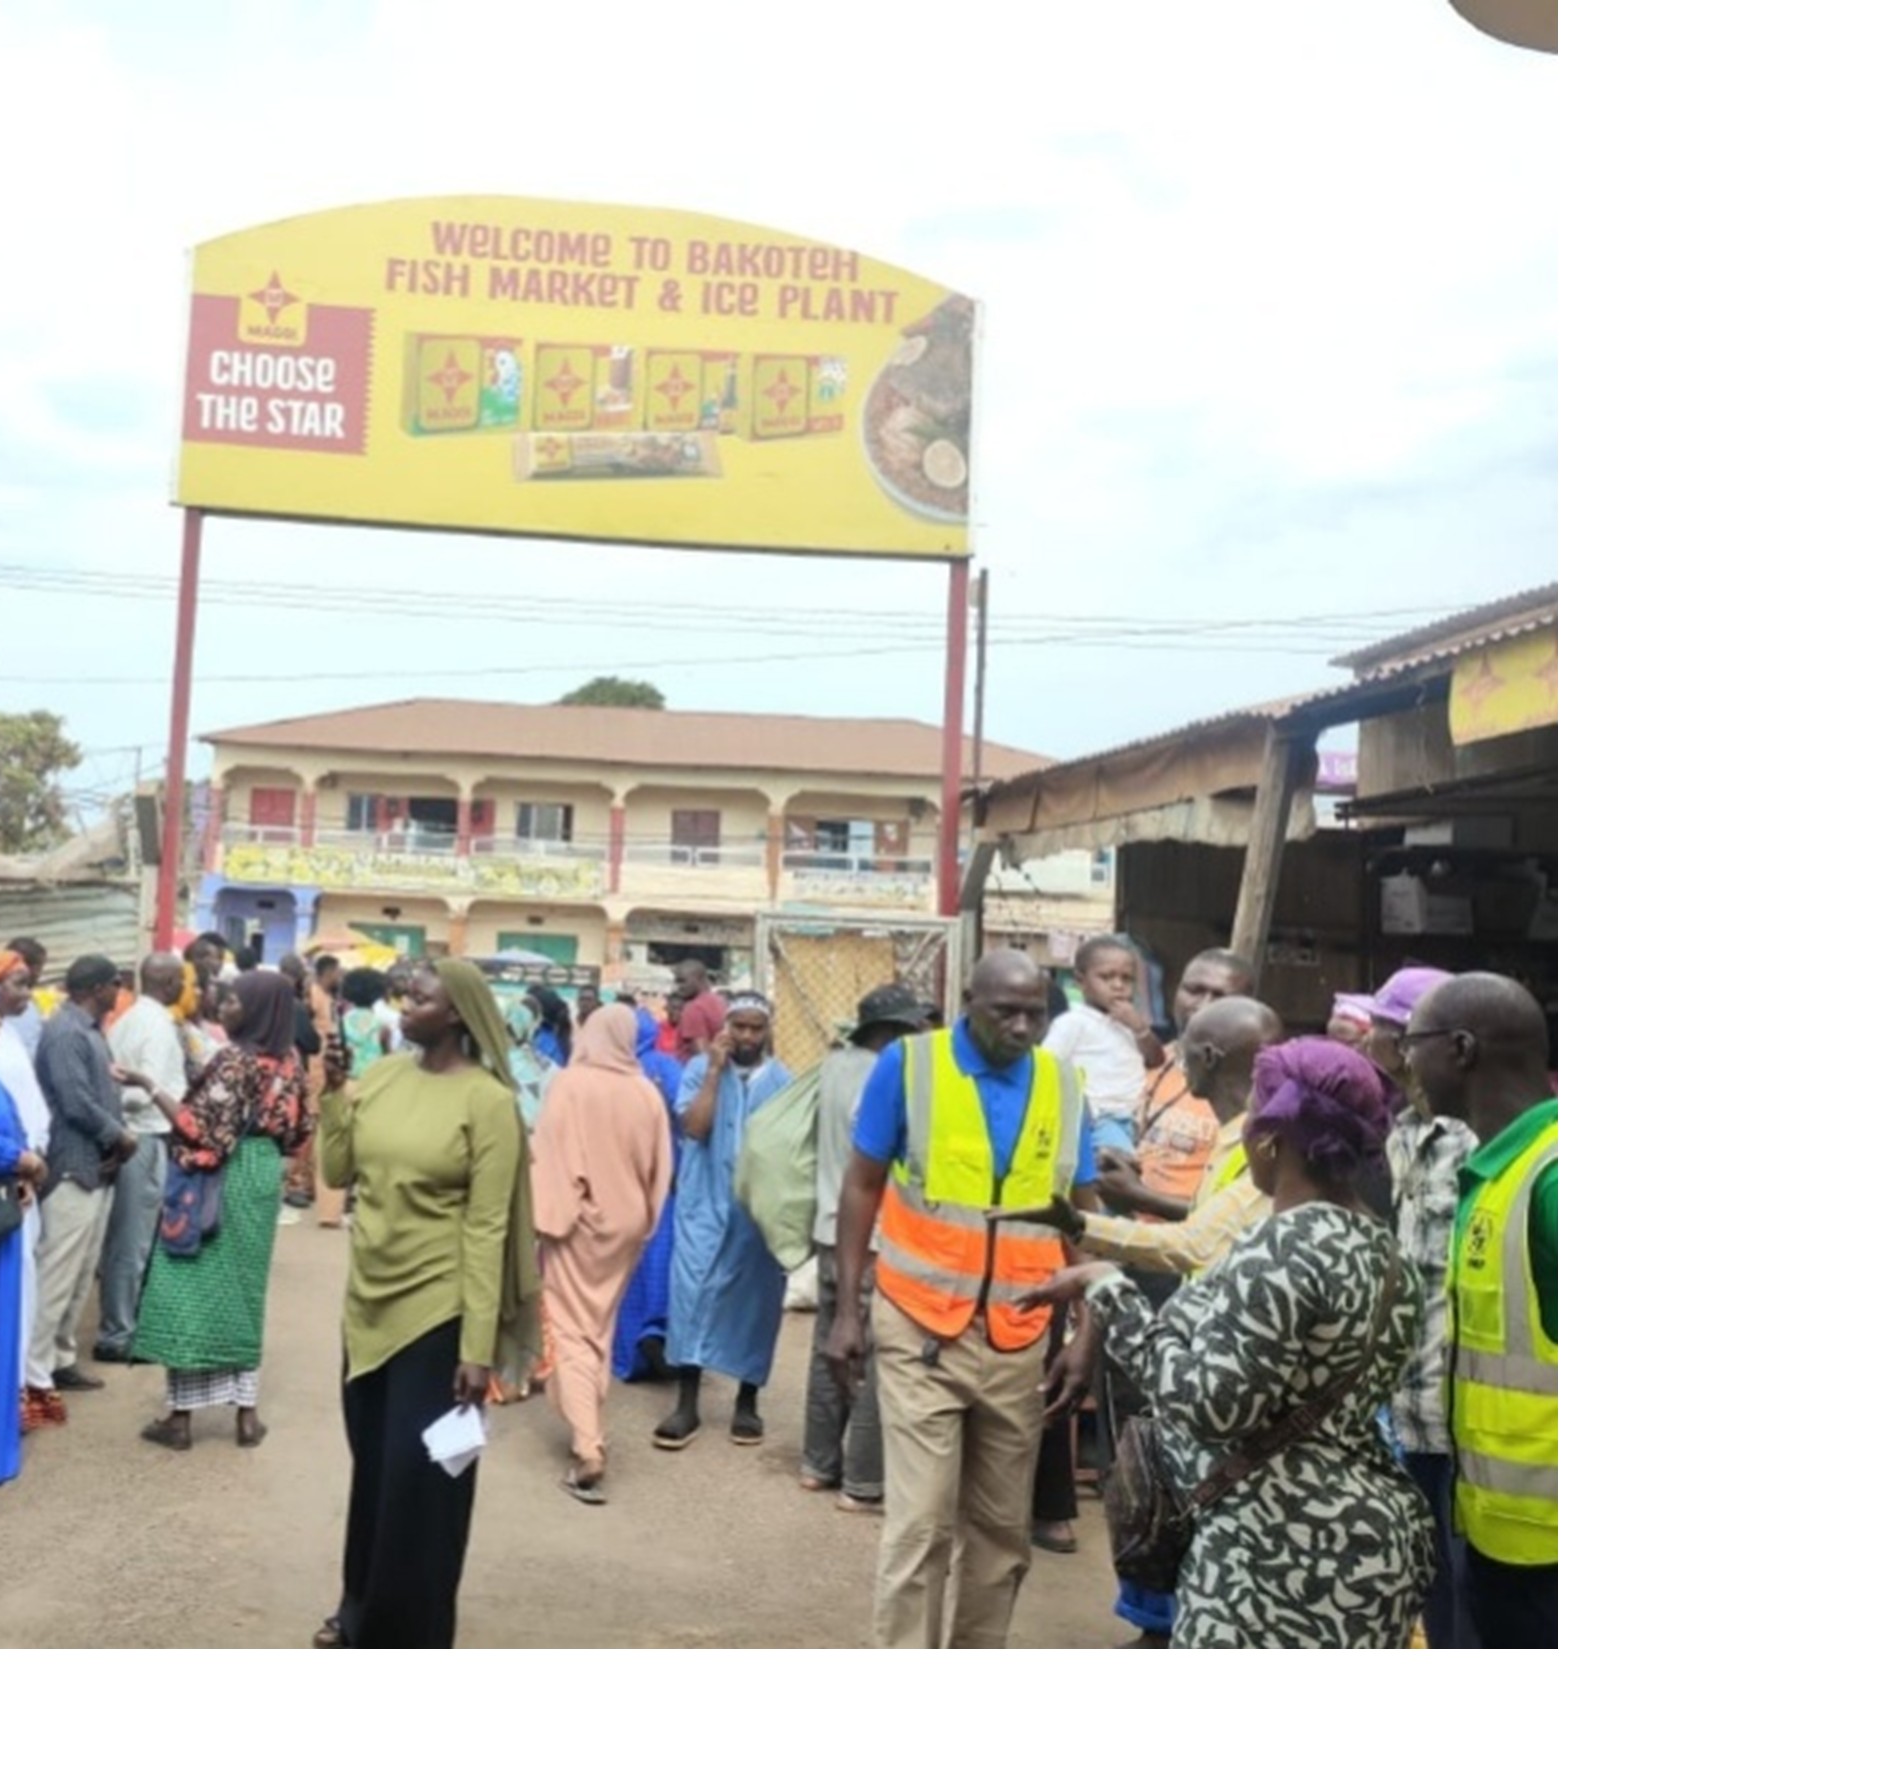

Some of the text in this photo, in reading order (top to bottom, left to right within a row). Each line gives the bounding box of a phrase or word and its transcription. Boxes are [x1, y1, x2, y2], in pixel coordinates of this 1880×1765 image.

[629, 237, 671, 272] TO
[385, 257, 470, 298] FISH
[658, 278, 683, 313] &
[777, 284, 900, 325] PLANT
[266, 397, 346, 439] STAR
